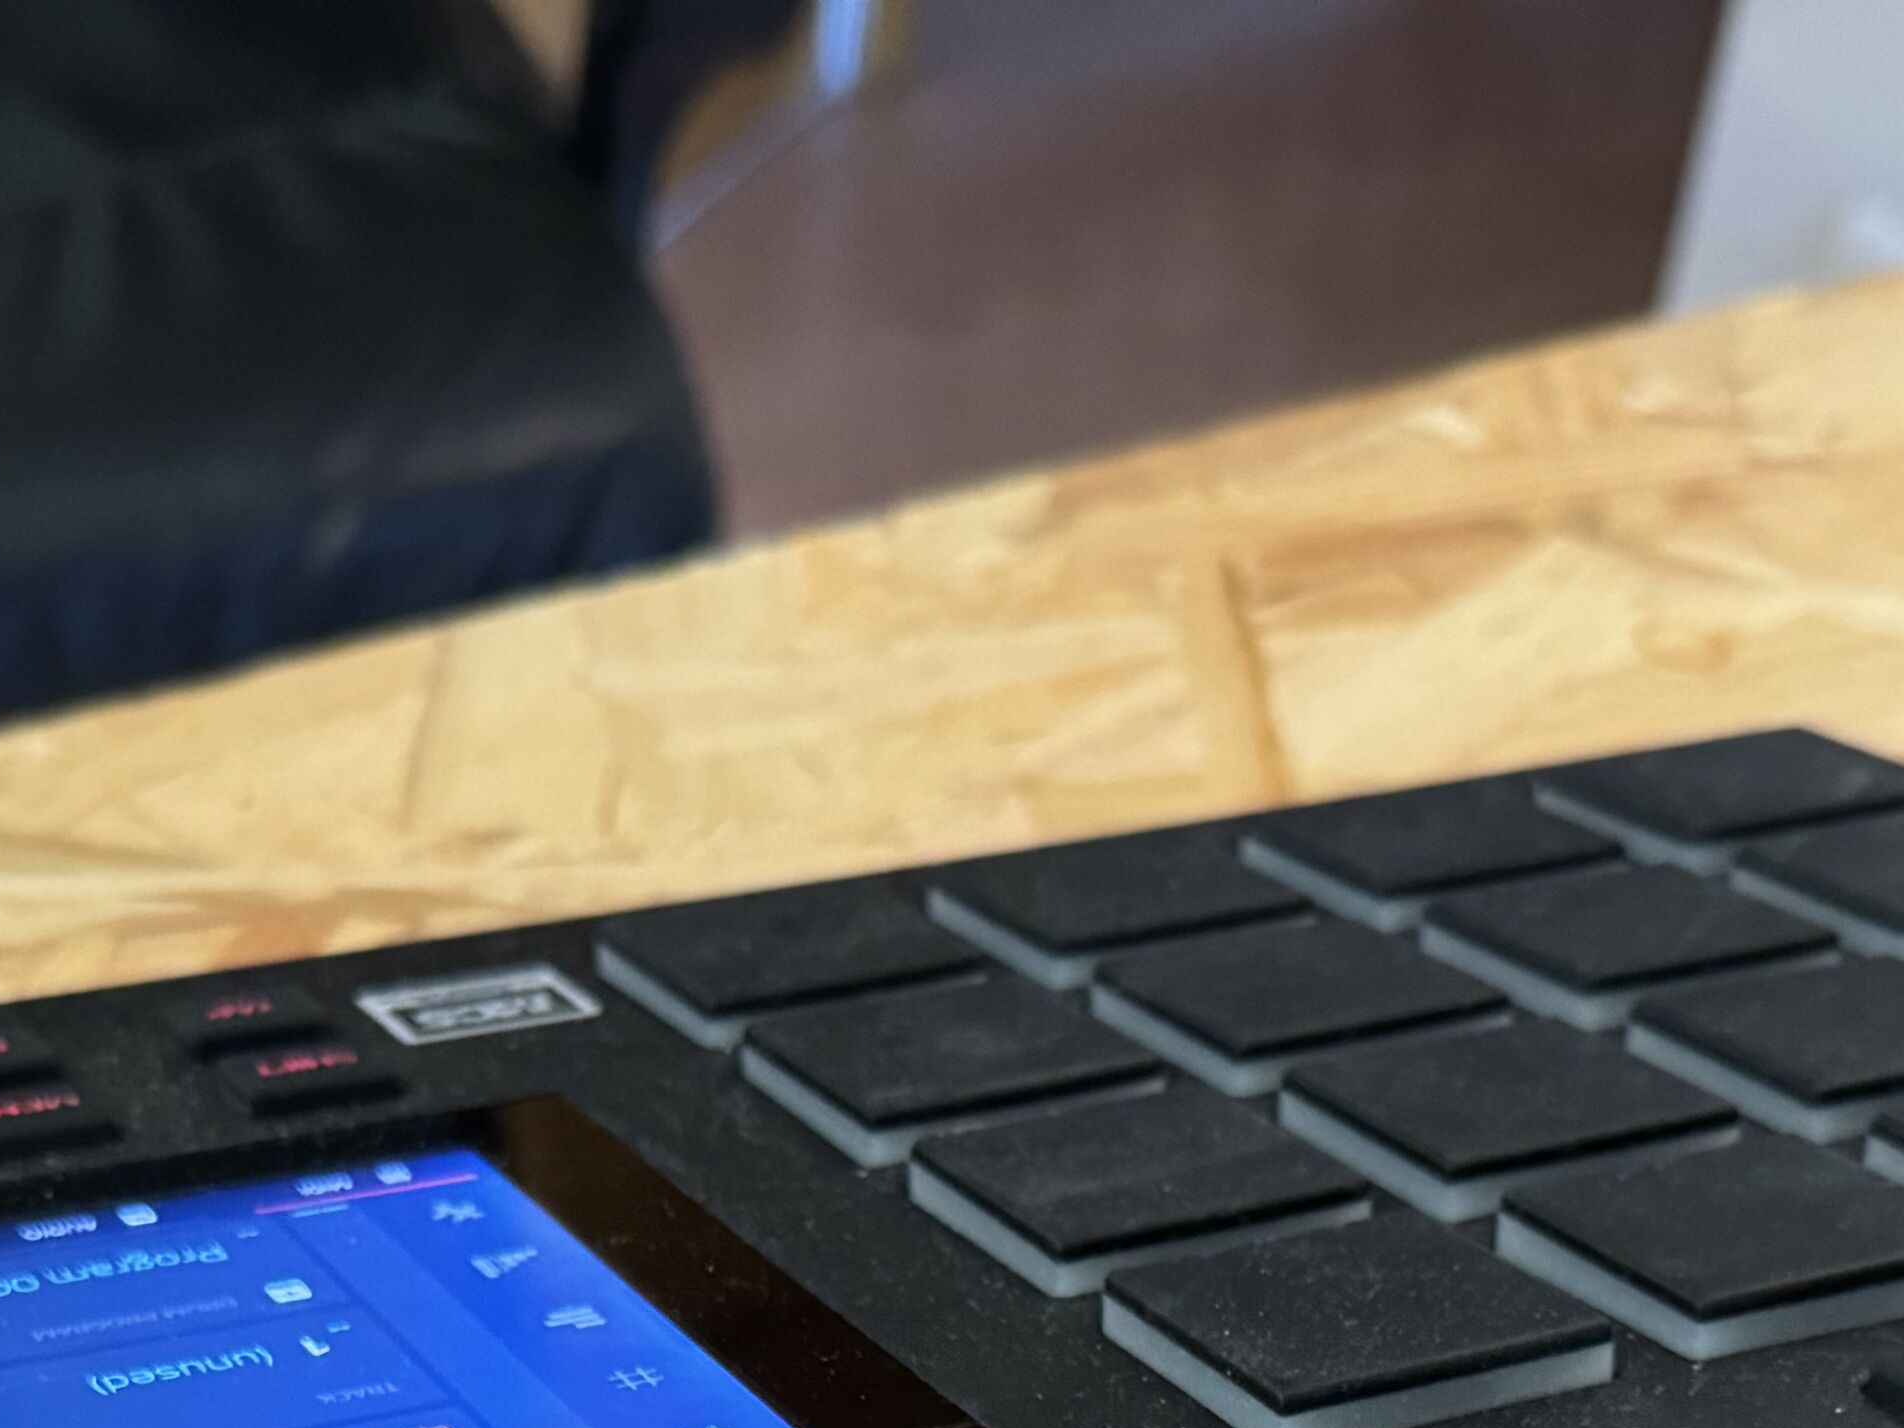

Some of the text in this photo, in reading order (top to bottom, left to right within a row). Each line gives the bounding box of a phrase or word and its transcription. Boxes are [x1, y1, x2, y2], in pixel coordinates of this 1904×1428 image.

[43, 1242, 229, 1289] Program
[86, 1347, 275, 1397] (unused)
[315, 1382, 401, 1405] TRACK
